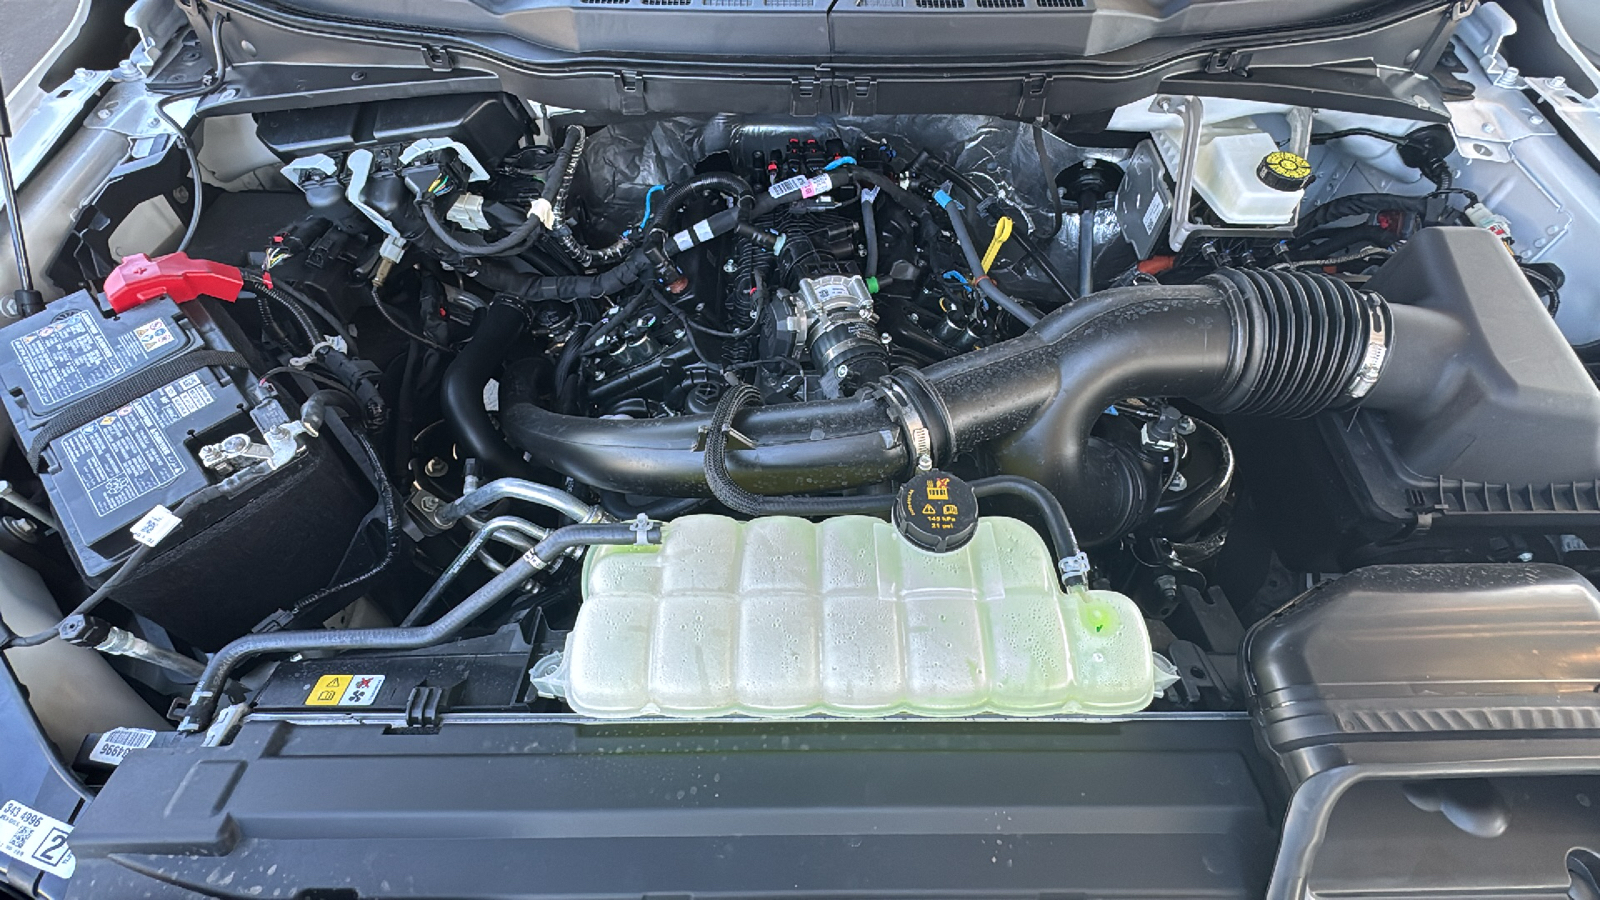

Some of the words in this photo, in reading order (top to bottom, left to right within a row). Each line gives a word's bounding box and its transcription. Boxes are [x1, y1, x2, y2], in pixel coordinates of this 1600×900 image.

[3, 803, 21, 818] 343
[20, 811, 44, 828] 4996
[40, 835, 66, 861] 2
